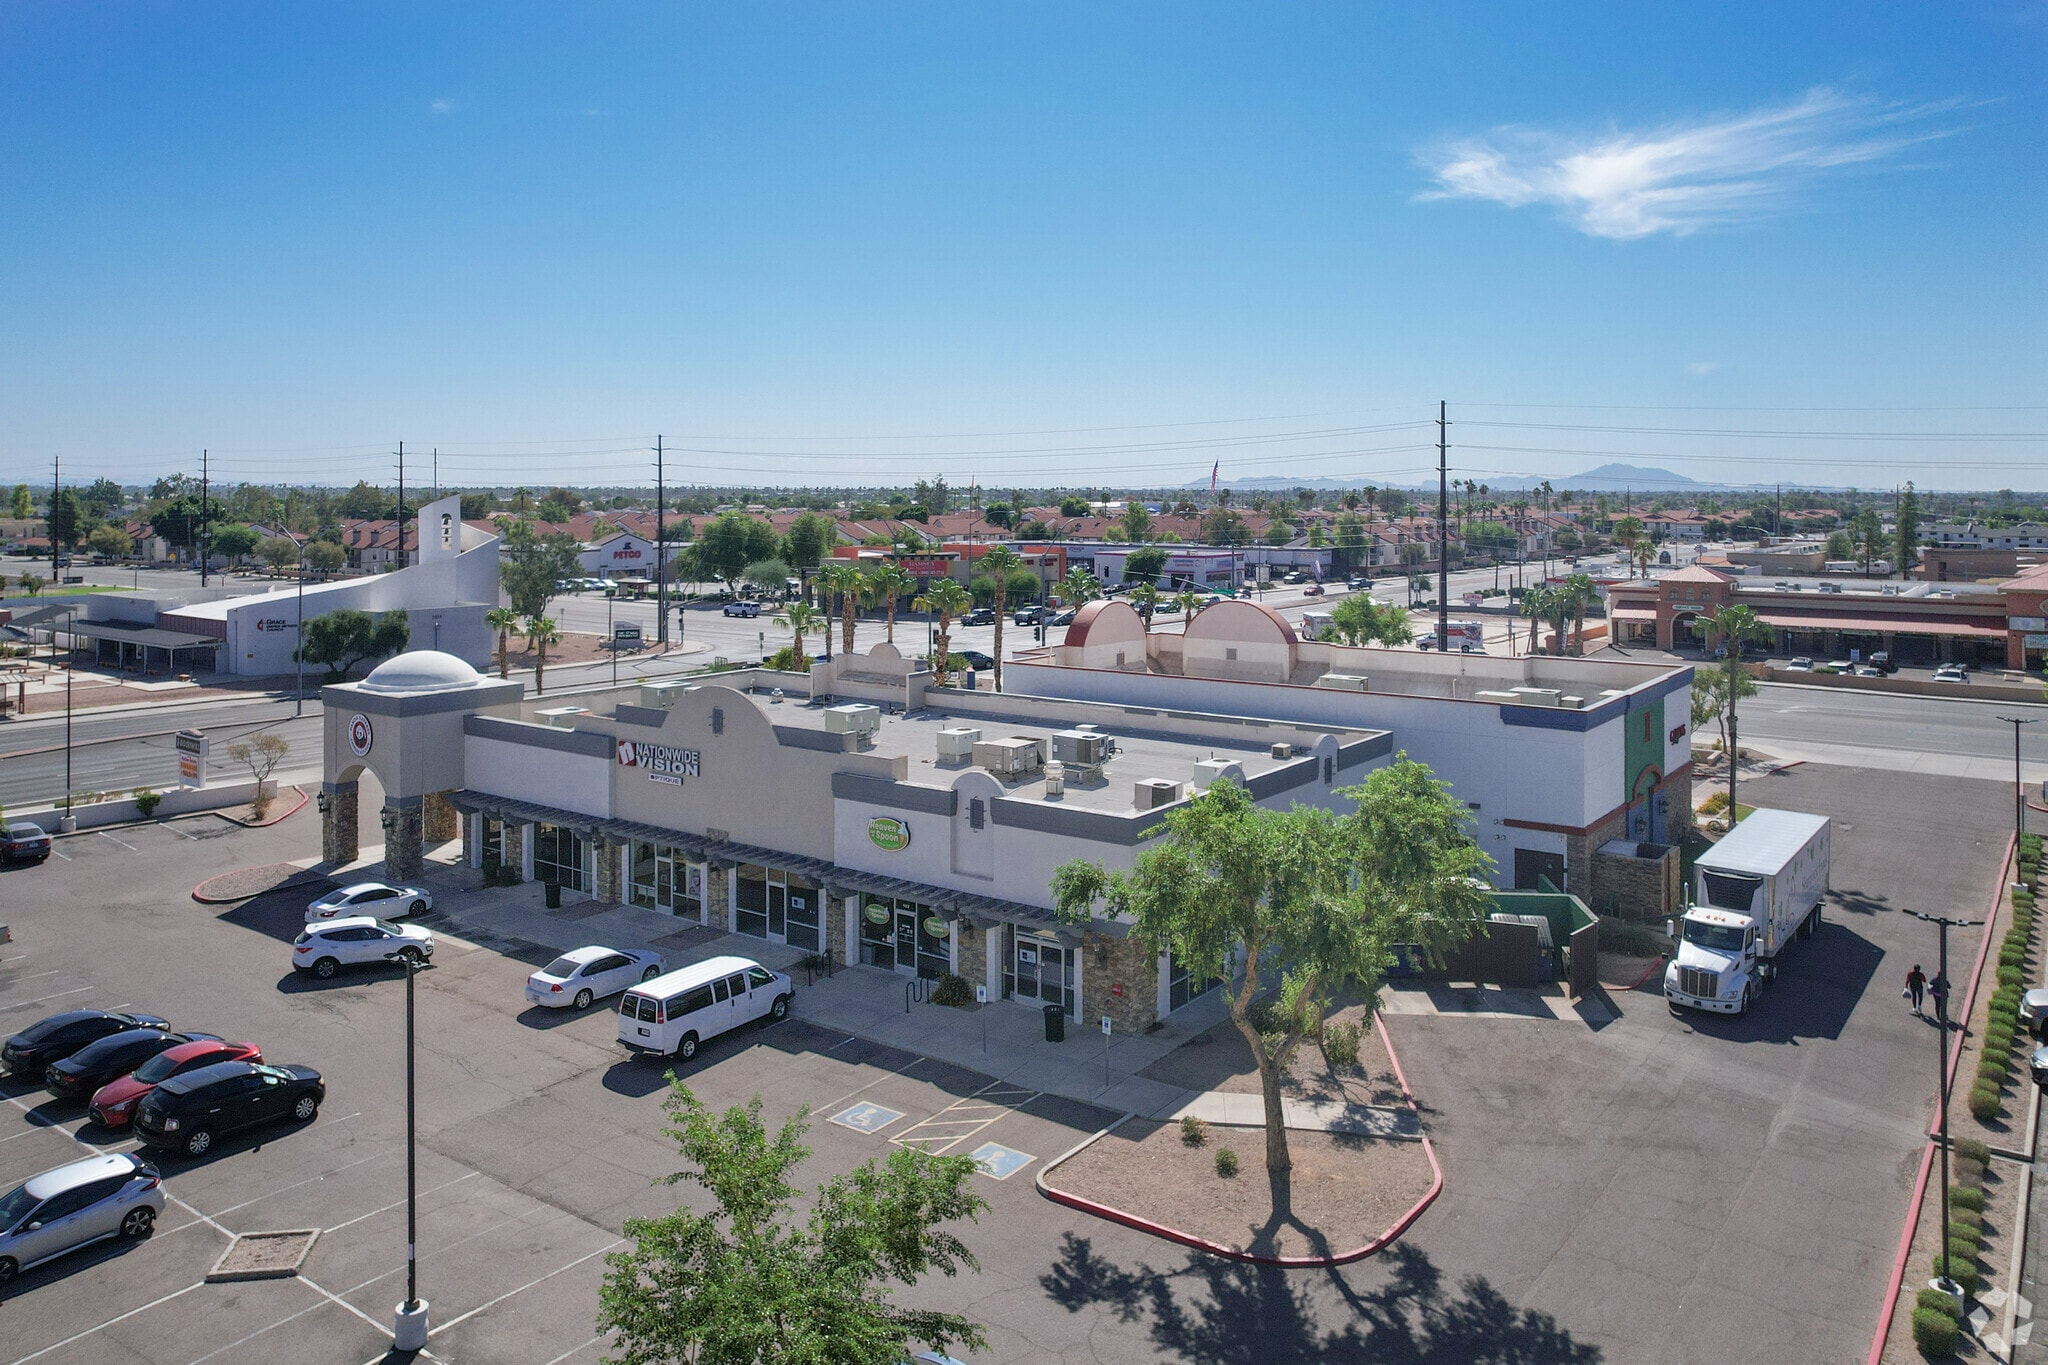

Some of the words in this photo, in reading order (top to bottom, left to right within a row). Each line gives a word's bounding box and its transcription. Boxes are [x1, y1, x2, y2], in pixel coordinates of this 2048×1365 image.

[613, 551, 641, 560] PETCO
[636, 743, 700, 764] NATIONWIDE
[635, 755, 700, 777] VISION
[870, 821, 896, 832] Heaven
[875, 830, 899, 842] Spoon
